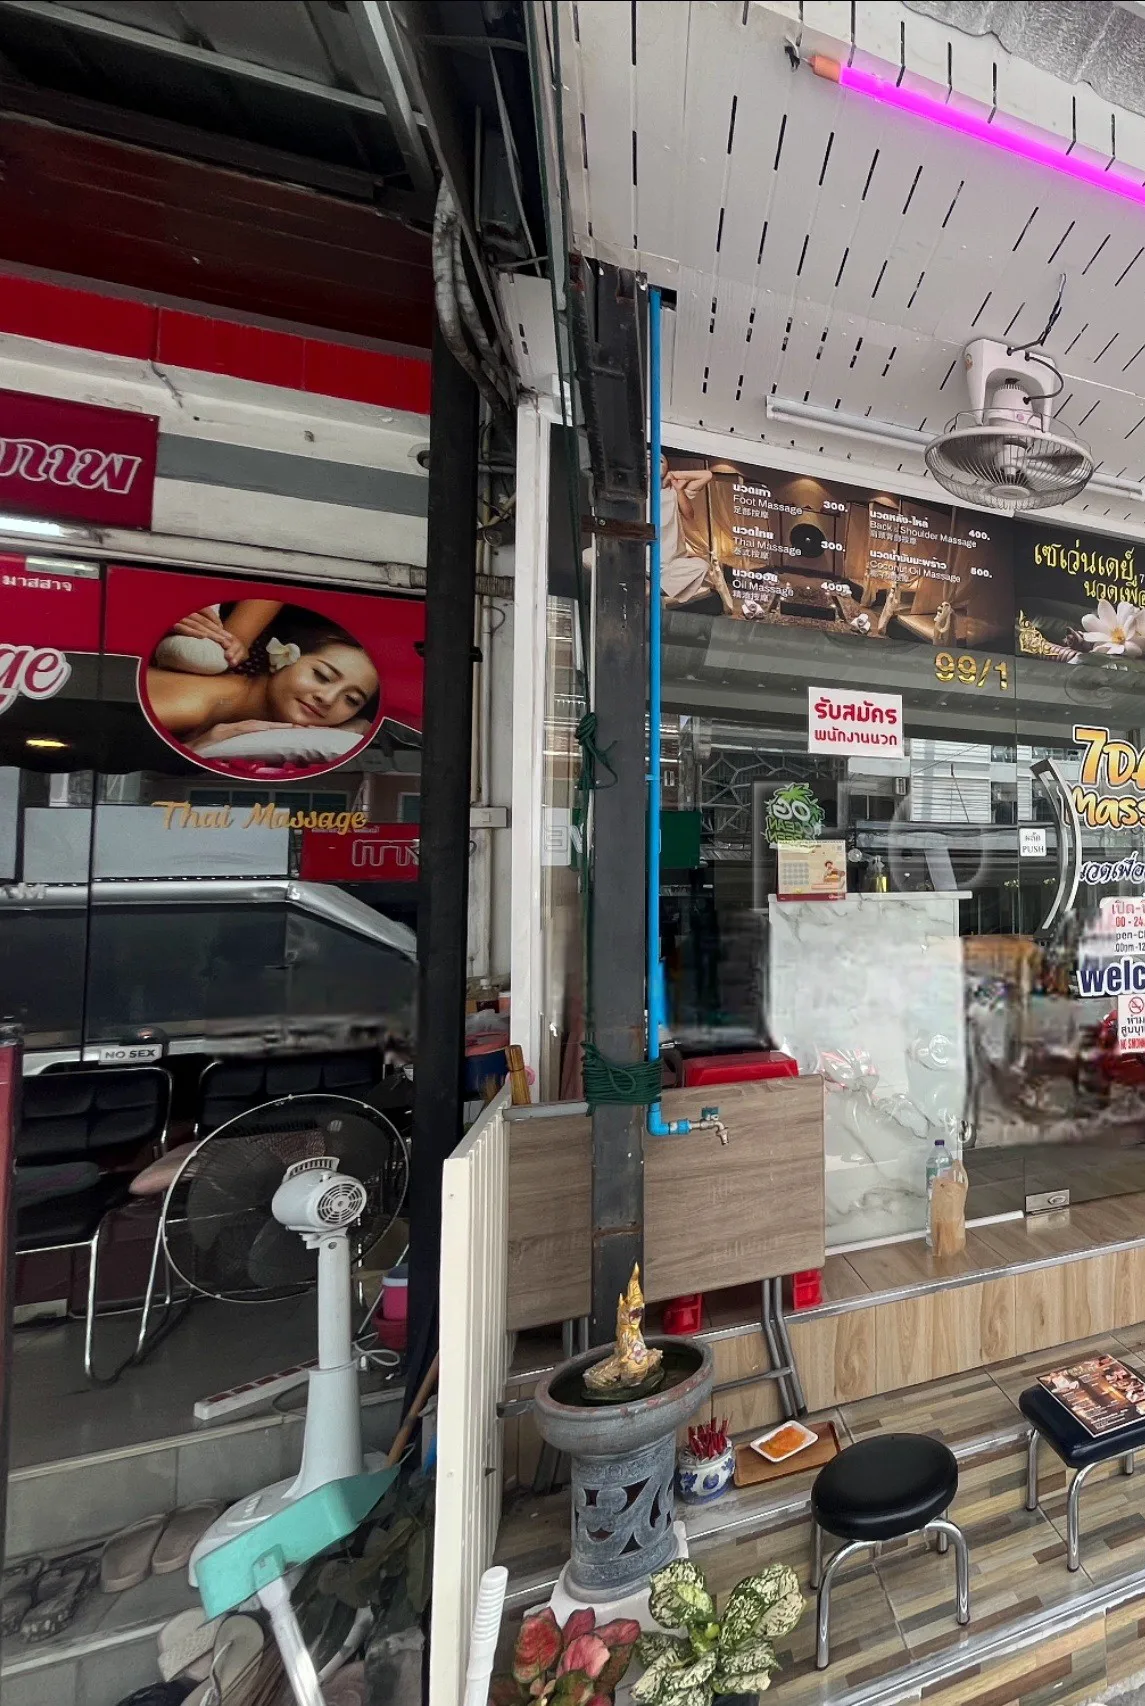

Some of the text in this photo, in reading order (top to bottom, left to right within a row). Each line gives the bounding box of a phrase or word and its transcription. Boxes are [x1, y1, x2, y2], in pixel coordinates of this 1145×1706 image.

[733, 494, 803, 516] Foot Massage
[869, 520, 893, 532] Back
[900, 525, 938, 541] Shoulder
[940, 533, 977, 549] Massage
[733, 536, 802, 557] Thai Massage
[869, 560, 908, 574] Coconut
[909, 564, 922, 576] Oil
[923, 569, 961, 583] Massage
[732, 578, 794, 597] Oil Massage
[934, 652, 1009, 690] 99/1
[814, 697, 898, 725] รับสมัคร
[814, 726, 898, 746] พนักงานนวด
[151, 800, 369, 837] Thai Massage
[1022, 845, 1045, 854] PUSH
[105, 1049, 156, 1060] NO SEX
